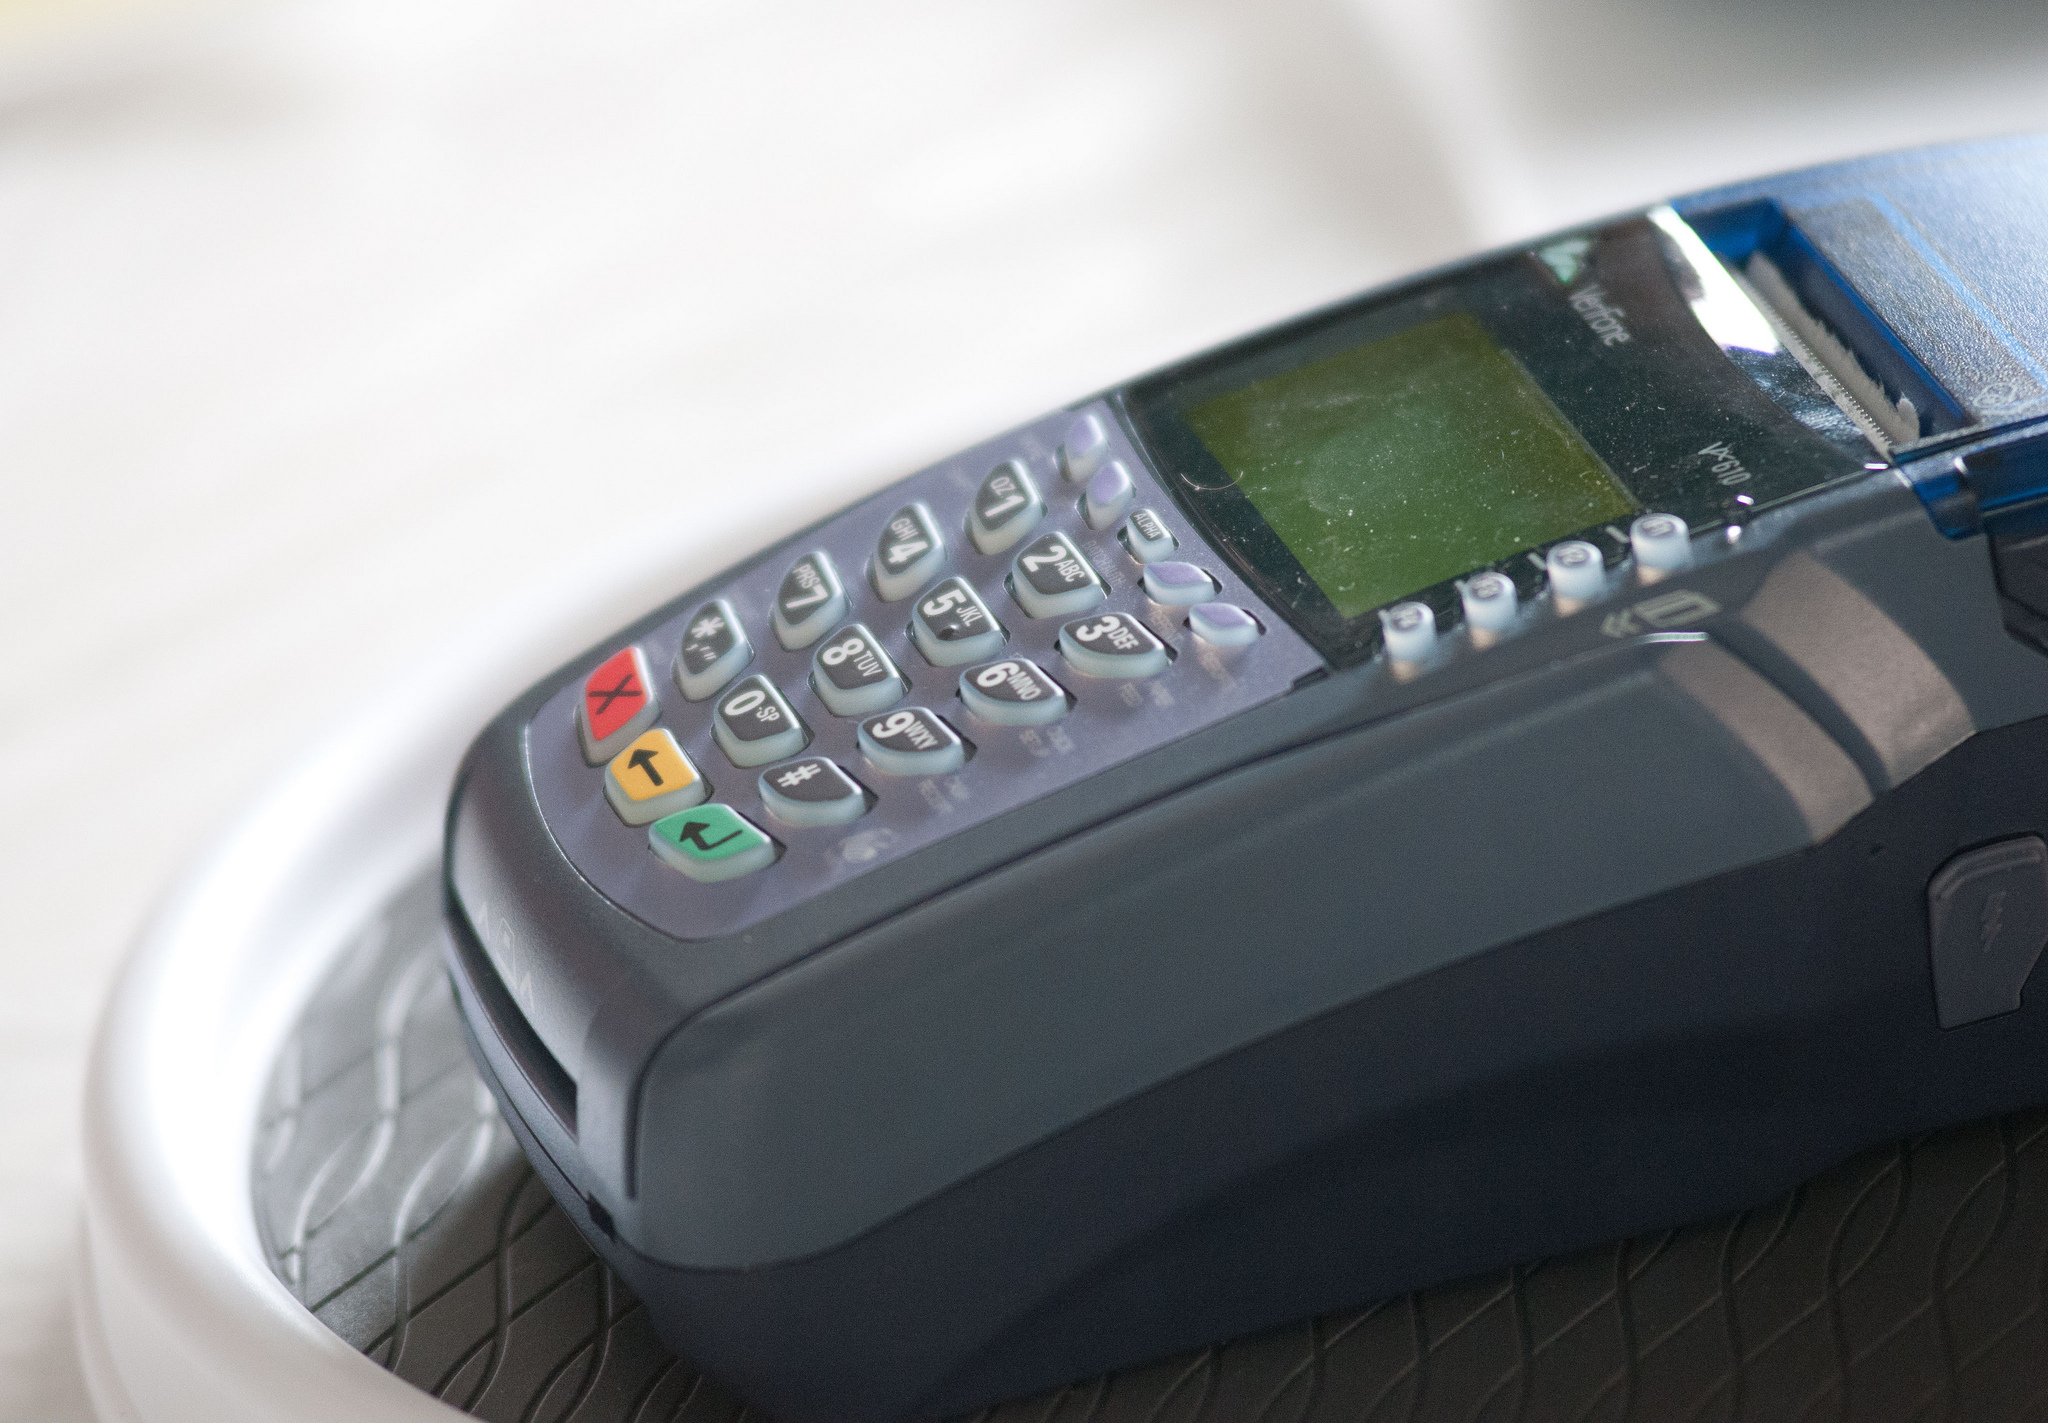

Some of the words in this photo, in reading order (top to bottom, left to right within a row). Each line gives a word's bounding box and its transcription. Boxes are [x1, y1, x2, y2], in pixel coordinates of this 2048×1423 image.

[985, 495, 1025, 517] 1
[891, 518, 918, 541] GHI
[1133, 512, 1163, 540] ALPHA
[888, 541, 929, 564] 4
[1022, 545, 1067, 572] 2
[1054, 559, 1086, 583] ABC
[792, 564, 820, 589] PRS
[786, 583, 829, 609] 7
[923, 589, 967, 617] 5
[957, 605, 983, 627] JKL
[1075, 615, 1121, 642] 3
[1107, 626, 1140, 650] DEF
[822, 638, 865, 665] 8
[853, 650, 882, 677] TUV
[976, 661, 1020, 688] 6
[1006, 671, 1042, 700] MNO
[724, 690, 765, 716] 0
[872, 711, 915, 738] 9
[903, 721, 938, 749] WXY
